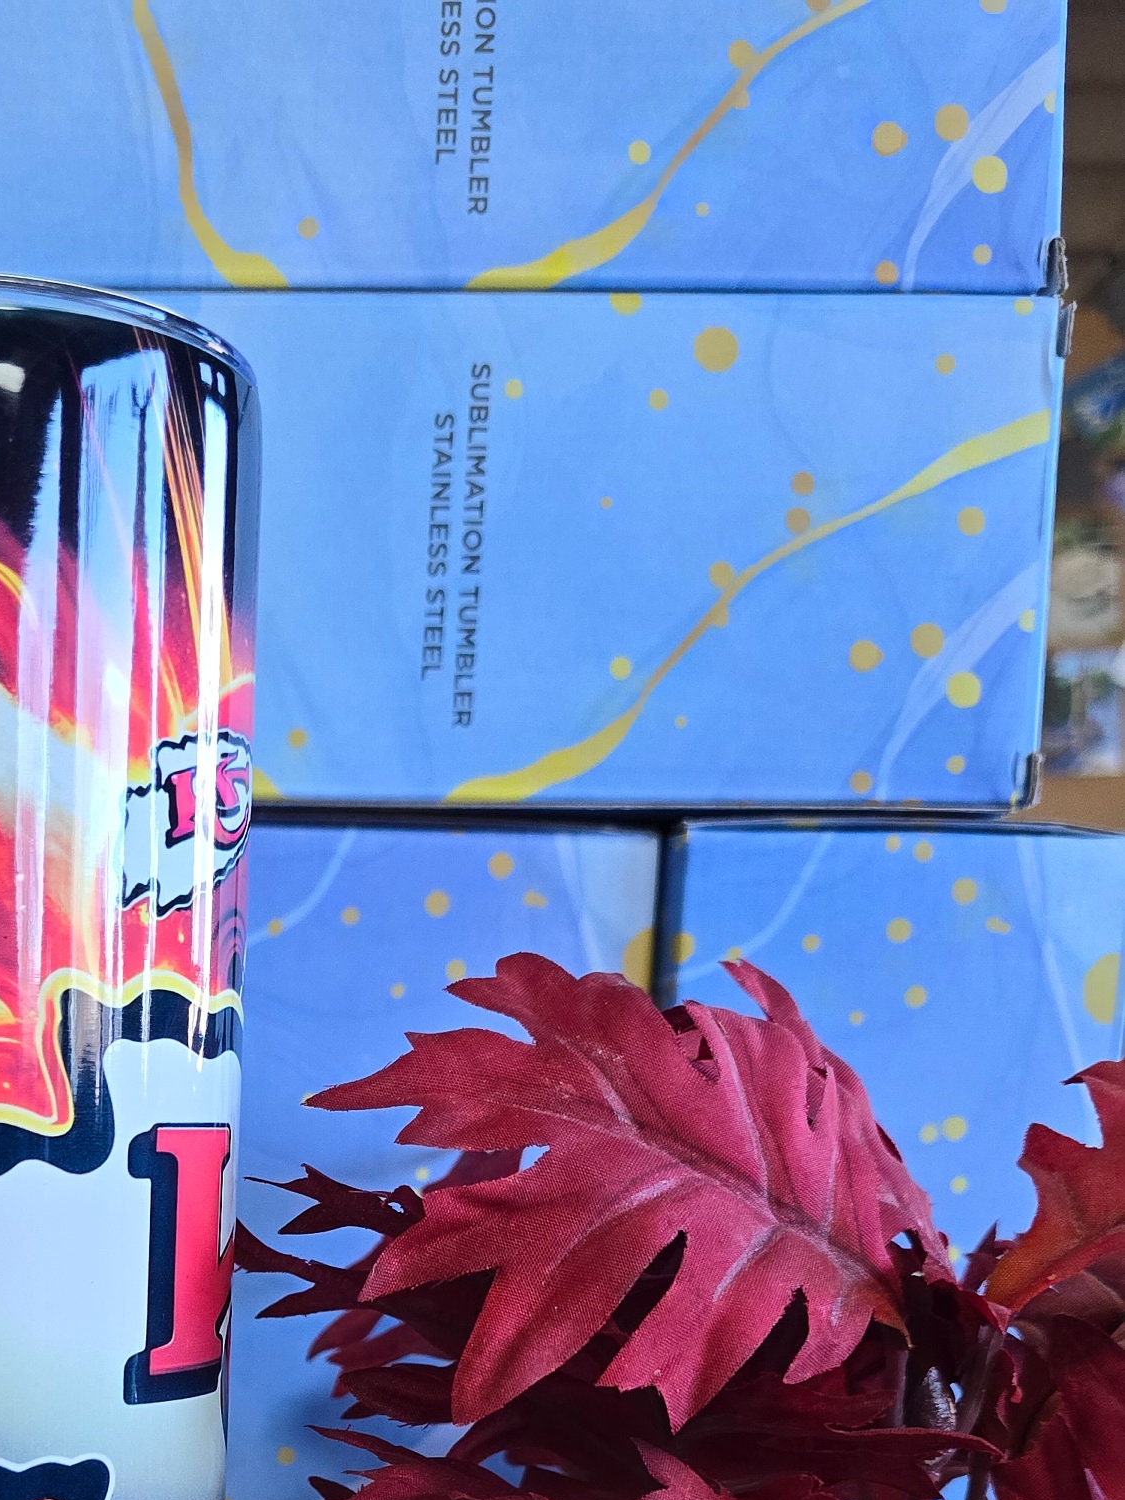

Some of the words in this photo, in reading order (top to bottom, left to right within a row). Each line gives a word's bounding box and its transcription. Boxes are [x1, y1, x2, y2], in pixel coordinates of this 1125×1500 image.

[435, 68, 459, 165] STEEL
[467, 65, 494, 215] TUMBLER
[427, 413, 455, 577] STAINLESS
[460, 363, 491, 575] SUBLIMATION
[421, 588, 446, 680] STEEL
[452, 586, 479, 728] TUMBLER
